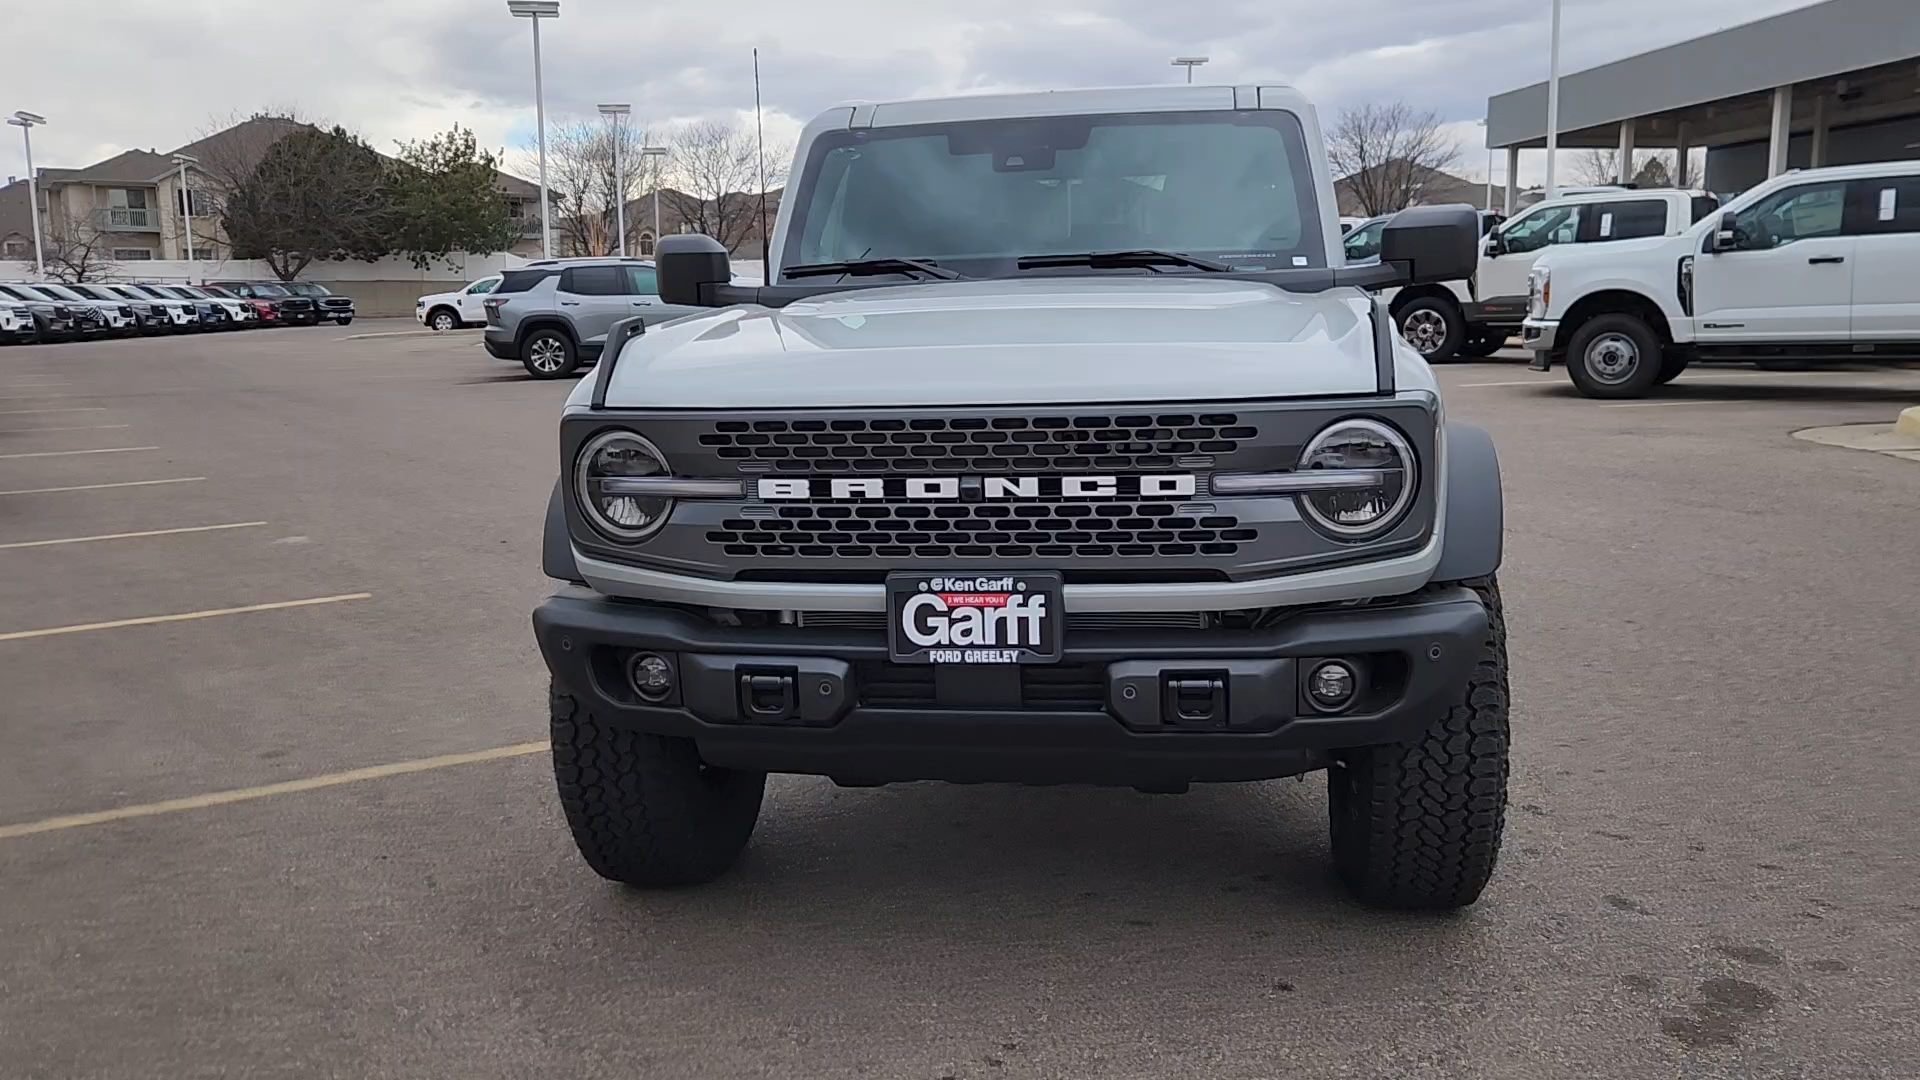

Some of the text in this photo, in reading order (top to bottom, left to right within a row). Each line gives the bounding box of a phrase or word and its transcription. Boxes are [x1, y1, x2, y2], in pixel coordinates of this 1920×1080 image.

[757, 474, 1197, 500] BRONCO
[944, 577, 1014, 592] Ken Garff
[952, 596, 999, 604] WE HEAR YOU
[902, 593, 1046, 647] Garff
[929, 650, 1019, 663] FORD GREELEY
